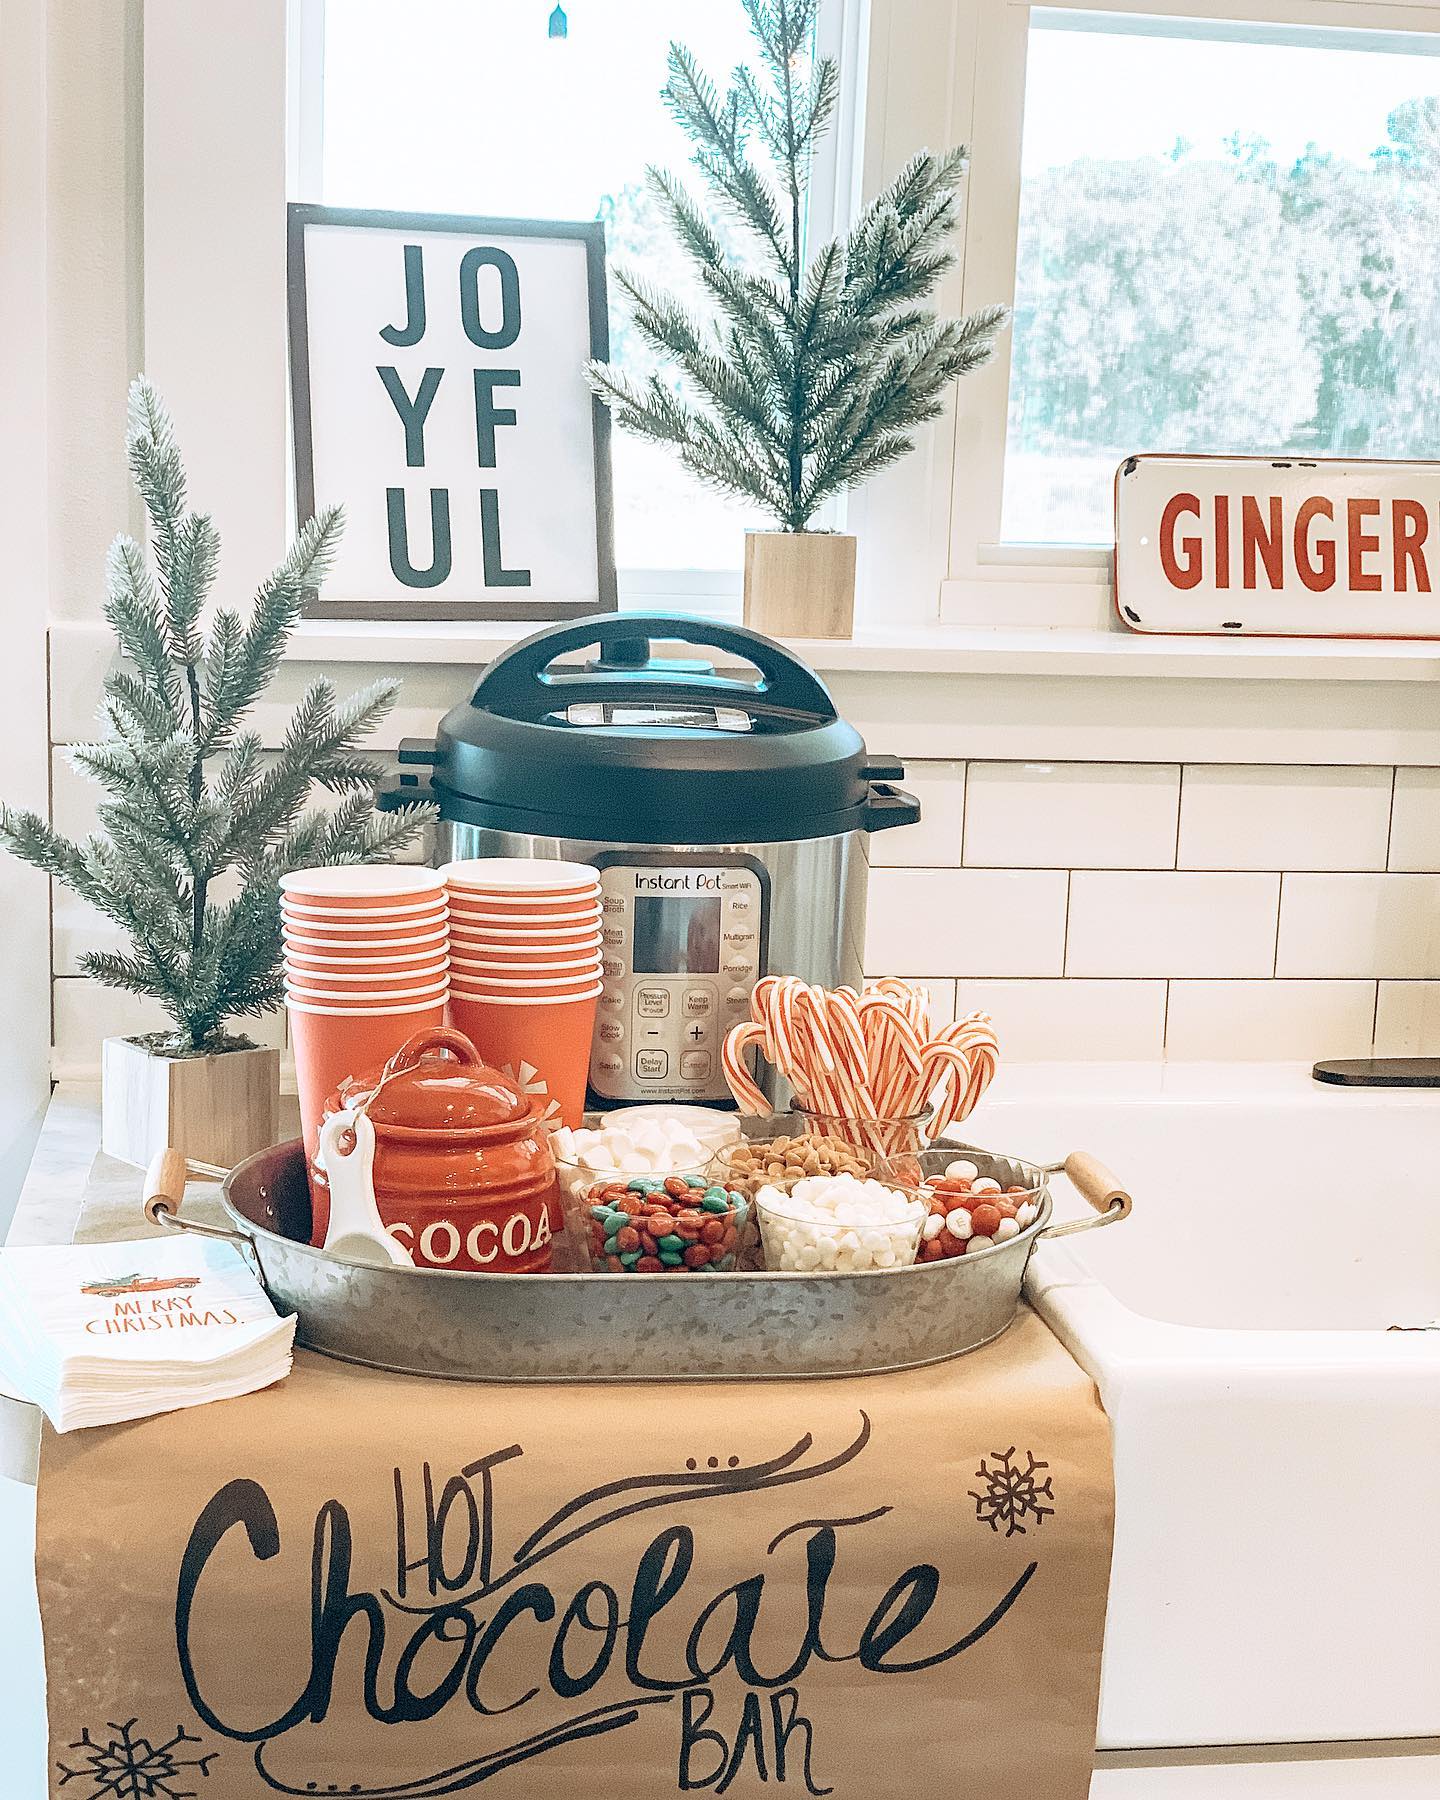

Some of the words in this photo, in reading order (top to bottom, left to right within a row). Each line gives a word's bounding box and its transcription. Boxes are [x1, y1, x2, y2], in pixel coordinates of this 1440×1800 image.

[1159, 493, 1440, 593] GINGER
[635, 872, 690, 890] Instant
[696, 873, 721, 890] Pot
[604, 896, 625, 905] Soup
[603, 904, 625, 913] Broth
[732, 902, 749, 910] Rice
[723, 933, 755, 942] Multigrain
[603, 960, 623, 968] Bean
[604, 969, 621, 977] Chili
[722, 964, 753, 974] Porridge
[601, 995, 622, 1004] Cake
[640, 992, 668, 1000] Pressure
[688, 995, 708, 1004] Keep
[601, 1023, 620, 1031] Slow
[600, 1031, 620, 1039] Cook
[640, 1057, 663, 1066] Delay
[642, 1065, 661, 1073] Start
[114, 1295, 193, 1316] MERRY
[393, 1444, 524, 1598] HOT
[678, 1687, 834, 1796] BAR
